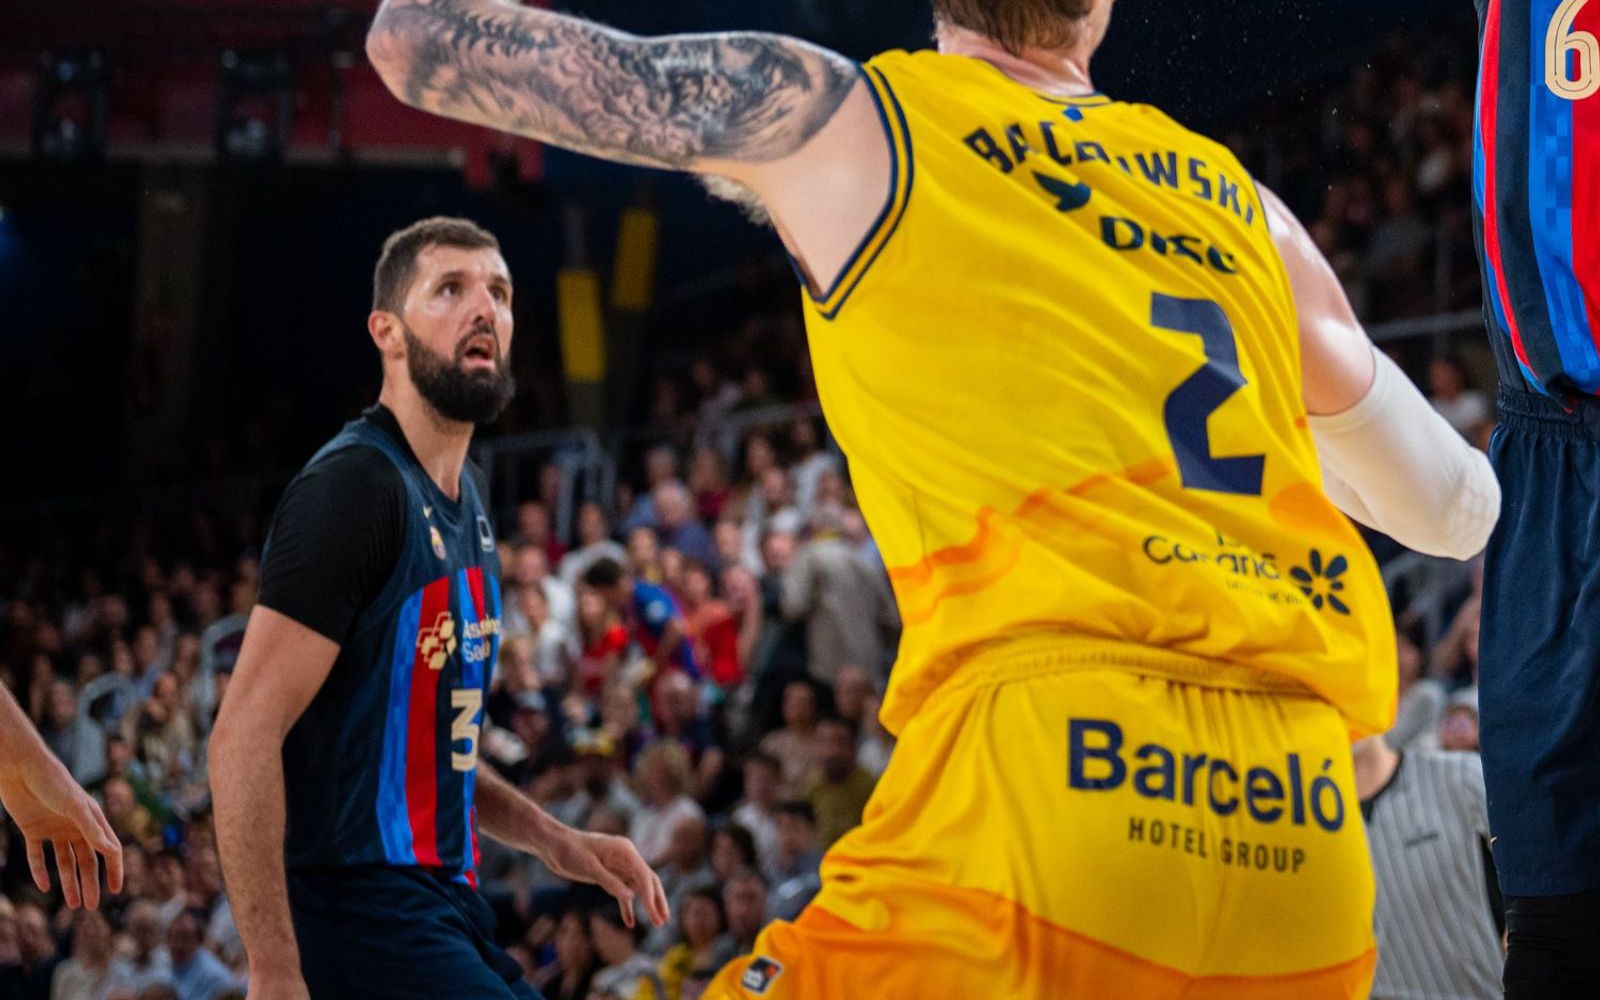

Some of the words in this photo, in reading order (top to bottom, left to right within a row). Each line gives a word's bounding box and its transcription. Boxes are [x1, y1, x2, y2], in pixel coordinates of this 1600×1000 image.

[1150, 290, 1266, 497] 2
[1067, 716, 1344, 833] Barceló
[1127, 816, 1208, 858] HOTEL
[1219, 838, 1306, 874] GROUP
